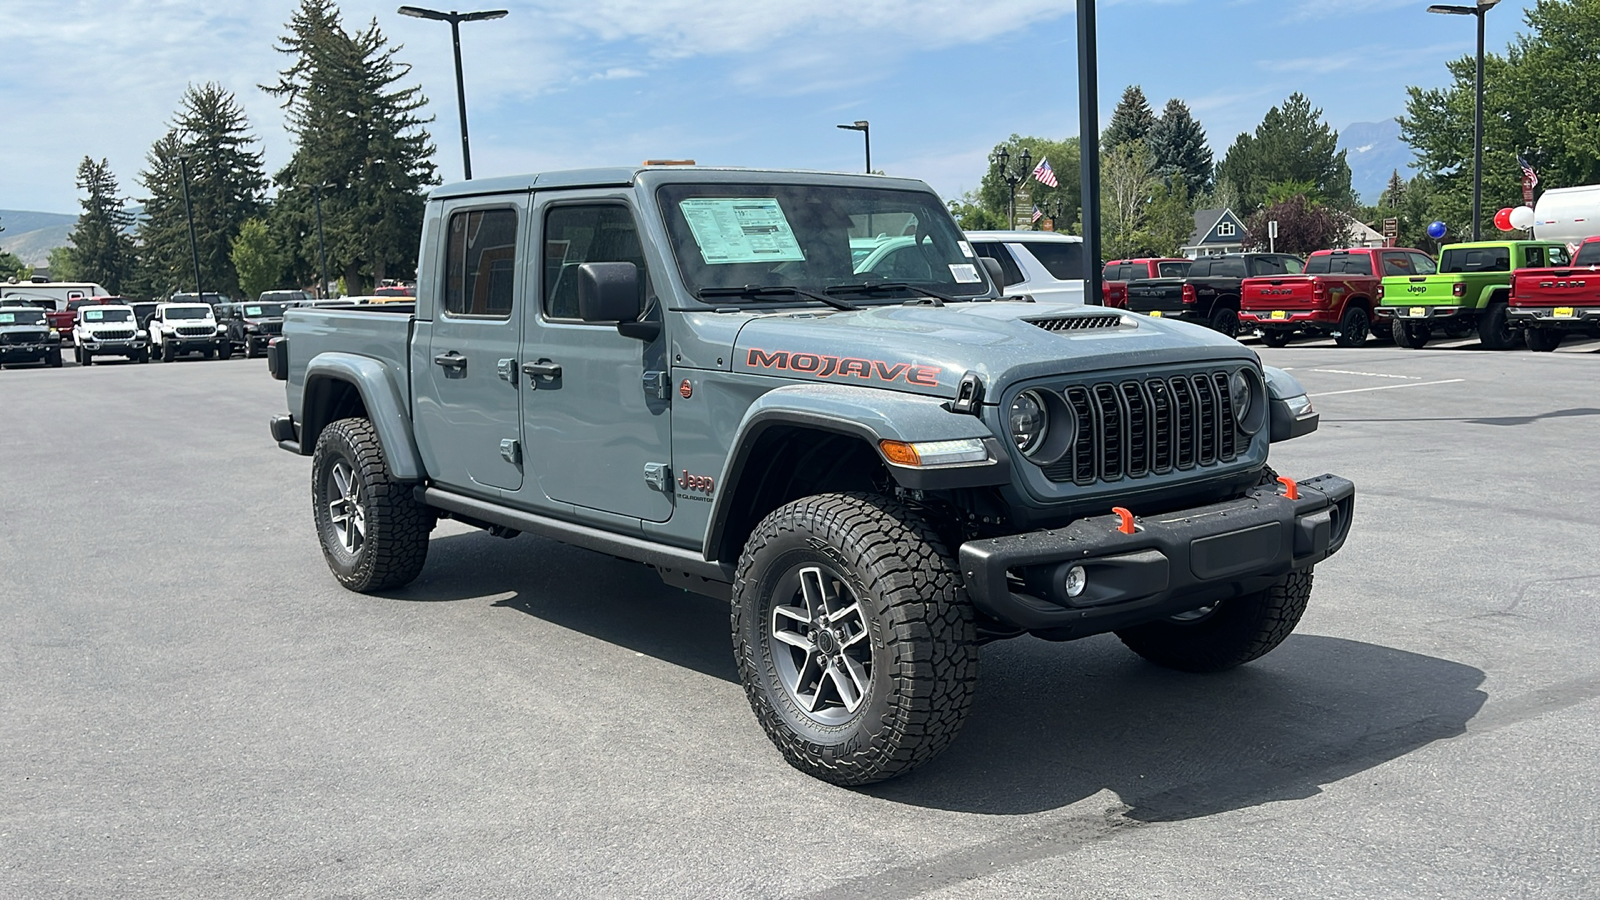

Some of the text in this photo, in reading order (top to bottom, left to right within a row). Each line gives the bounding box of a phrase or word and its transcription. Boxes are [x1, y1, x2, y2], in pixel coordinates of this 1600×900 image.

[1407, 285, 1427, 293] Jeep
[747, 348, 942, 387] MOJAVE
[677, 469, 715, 497] Jeep
